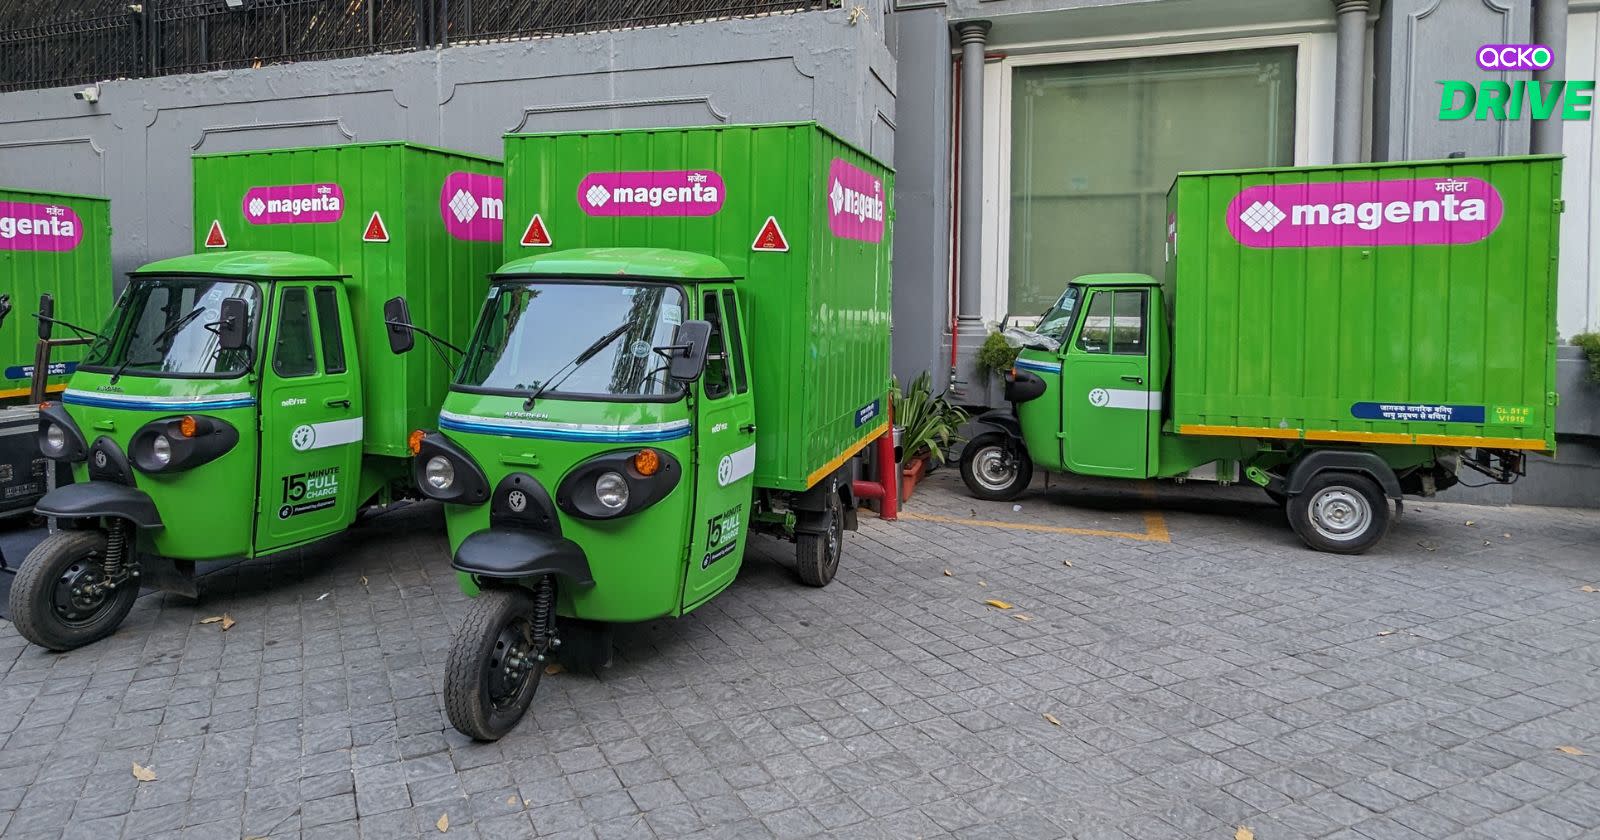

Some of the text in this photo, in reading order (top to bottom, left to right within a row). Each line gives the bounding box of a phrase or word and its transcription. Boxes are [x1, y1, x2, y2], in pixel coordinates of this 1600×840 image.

[613, 182, 718, 207] magenta
[1434, 178, 1469, 192] मजेंटा
[267, 194, 340, 216] magenta
[844, 187, 883, 223] magenta
[1291, 194, 1486, 231] magenta
[0, 216, 75, 239] genta
[307, 466, 340, 479] MINUTE
[307, 474, 338, 491] FULL
[281, 473, 307, 504] 15
[306, 486, 338, 499] CHARGE
[723, 503, 742, 519] MINUTE
[706, 514, 723, 552] 15
[721, 512, 740, 534] FULL
[720, 526, 739, 544] CHARGE
